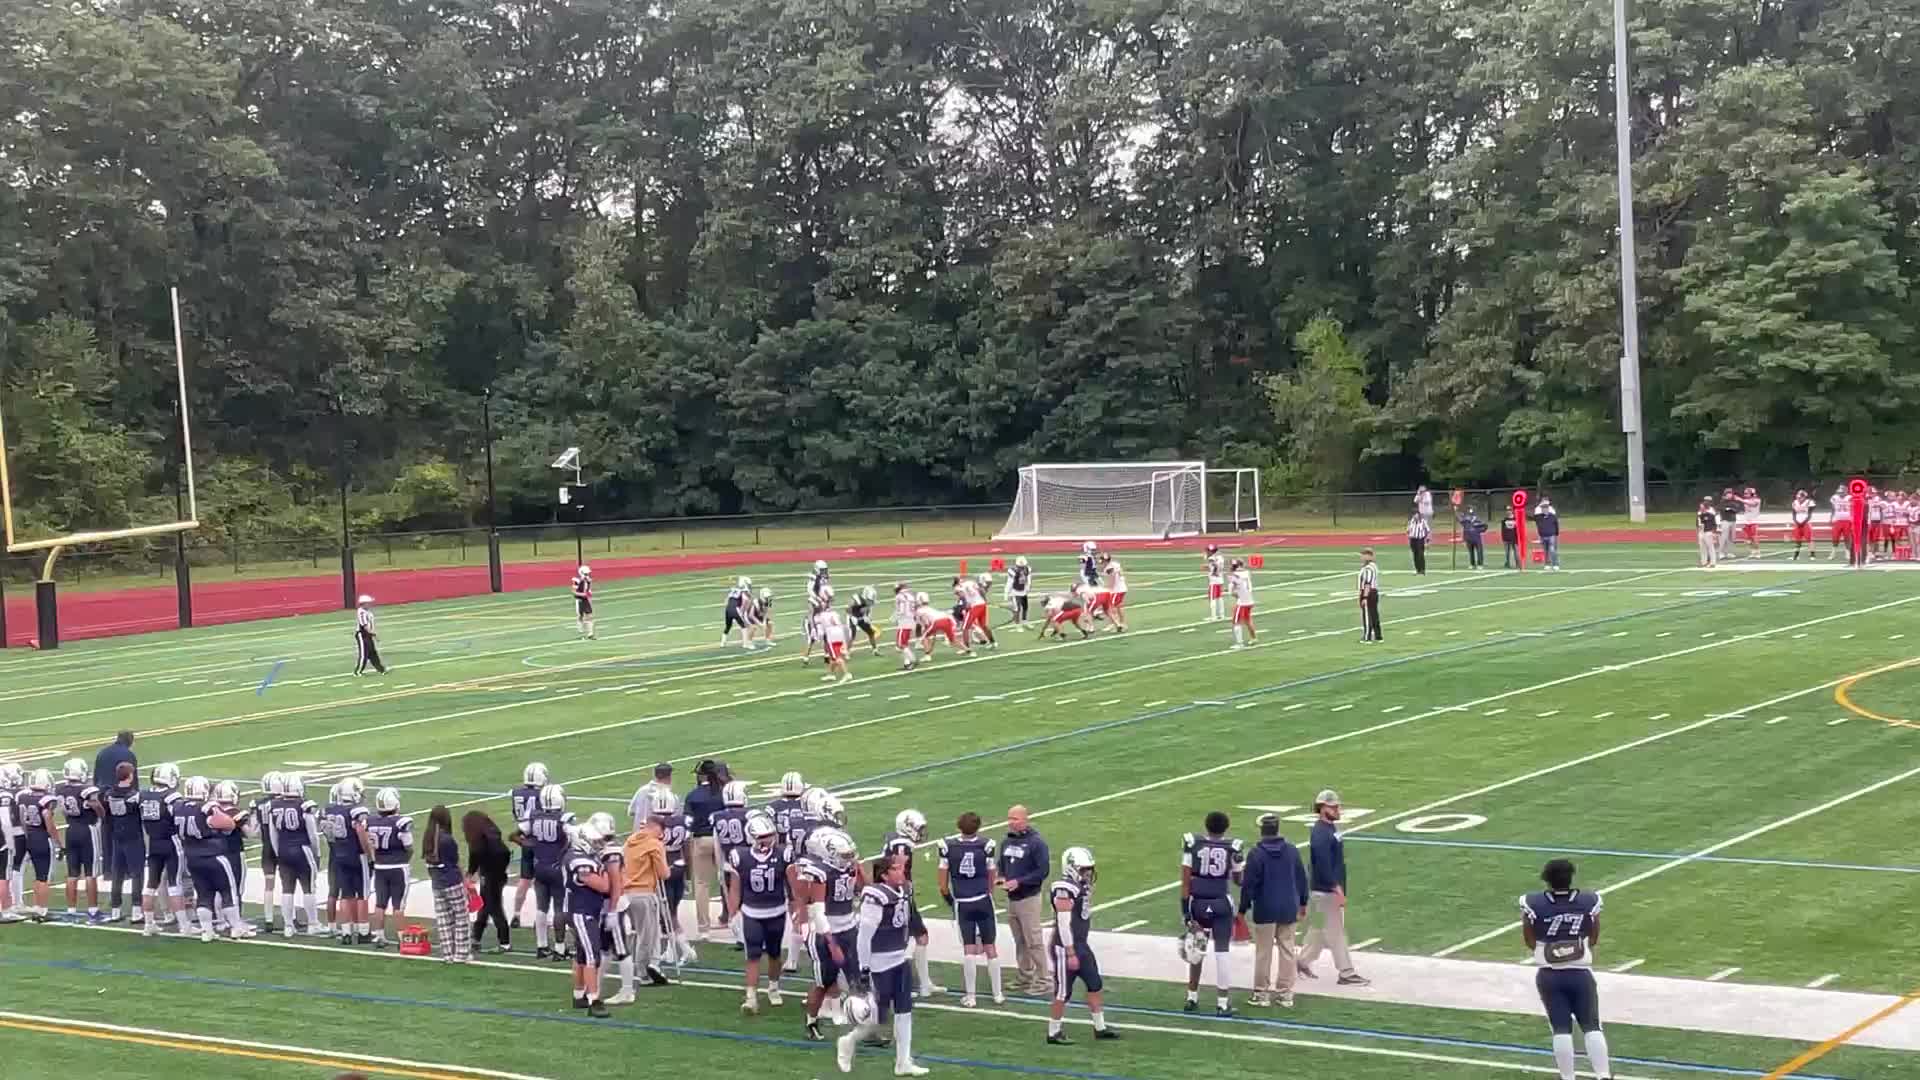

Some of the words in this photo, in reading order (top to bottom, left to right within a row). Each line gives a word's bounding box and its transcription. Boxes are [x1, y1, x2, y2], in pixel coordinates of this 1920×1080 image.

[272, 808, 301, 831] 70
[716, 818, 745, 845] 29
[959, 852, 976, 878] 4
[1197, 846, 1228, 877] 13
[1543, 912, 1585, 936] 77
